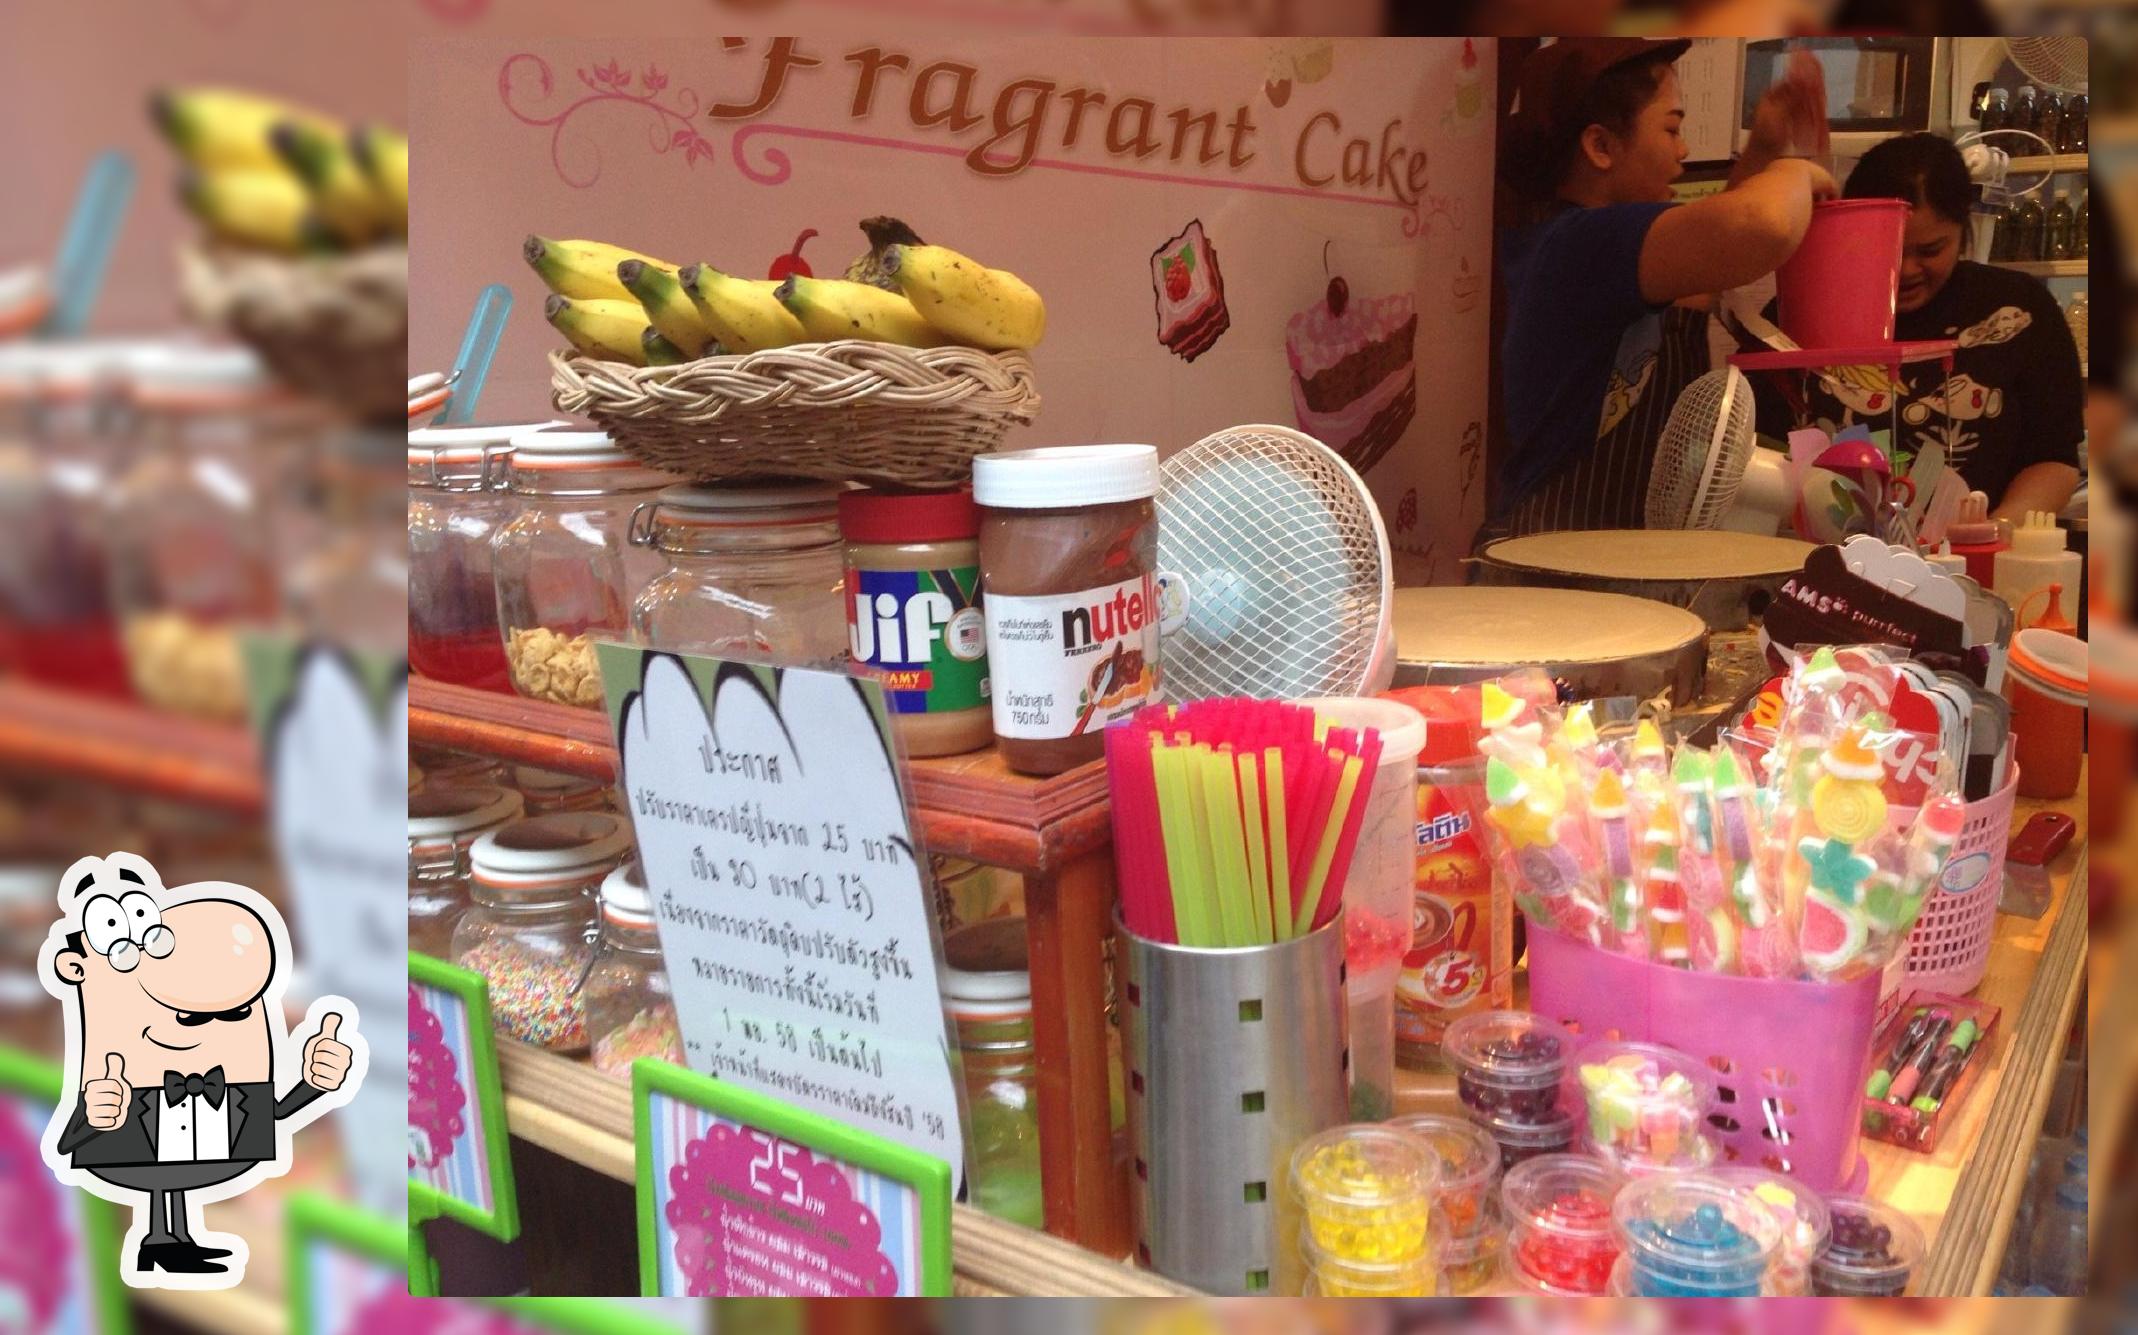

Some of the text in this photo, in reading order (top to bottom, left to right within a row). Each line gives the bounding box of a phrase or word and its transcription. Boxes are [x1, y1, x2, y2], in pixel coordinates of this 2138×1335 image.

[710, 37, 1429, 206] Fragrant Cake
[849, 592, 954, 663] Jif
[699, 734, 782, 783] ประกาศ
[690, 845, 720, 882] เป็น
[728, 857, 757, 890] 30
[821, 822, 848, 853] 25
[862, 836, 899, 866] บาท
[749, 1133, 804, 1208] 25
